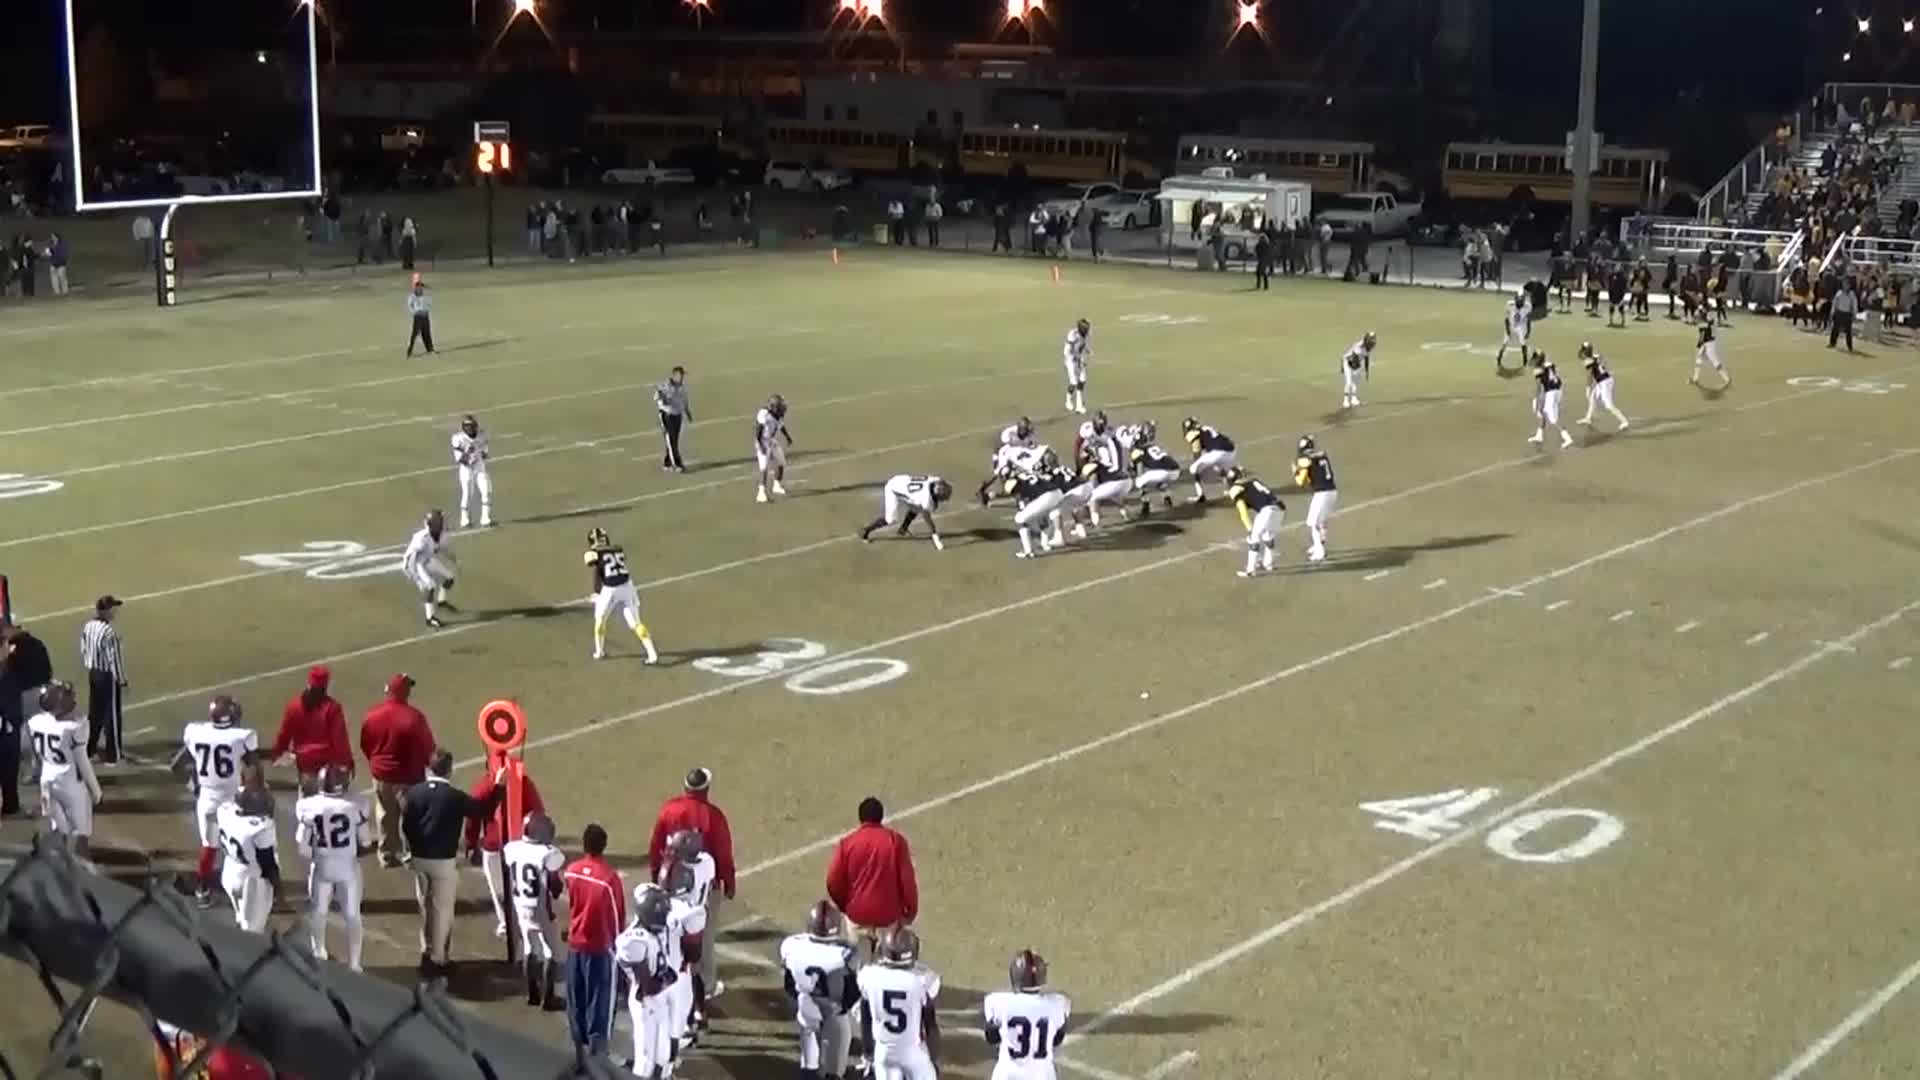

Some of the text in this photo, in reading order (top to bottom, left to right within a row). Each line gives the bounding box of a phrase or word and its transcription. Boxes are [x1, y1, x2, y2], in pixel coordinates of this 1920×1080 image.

[478, 141, 510, 172] 21
[603, 553, 629, 577] 25
[691, 637, 909, 695] 30
[195, 743, 234, 778] 76
[309, 814, 350, 848] 12
[1358, 787, 1625, 863] 40
[511, 861, 540, 897] 19
[883, 989, 907, 1034] 5
[1007, 1016, 1049, 1059] 31
